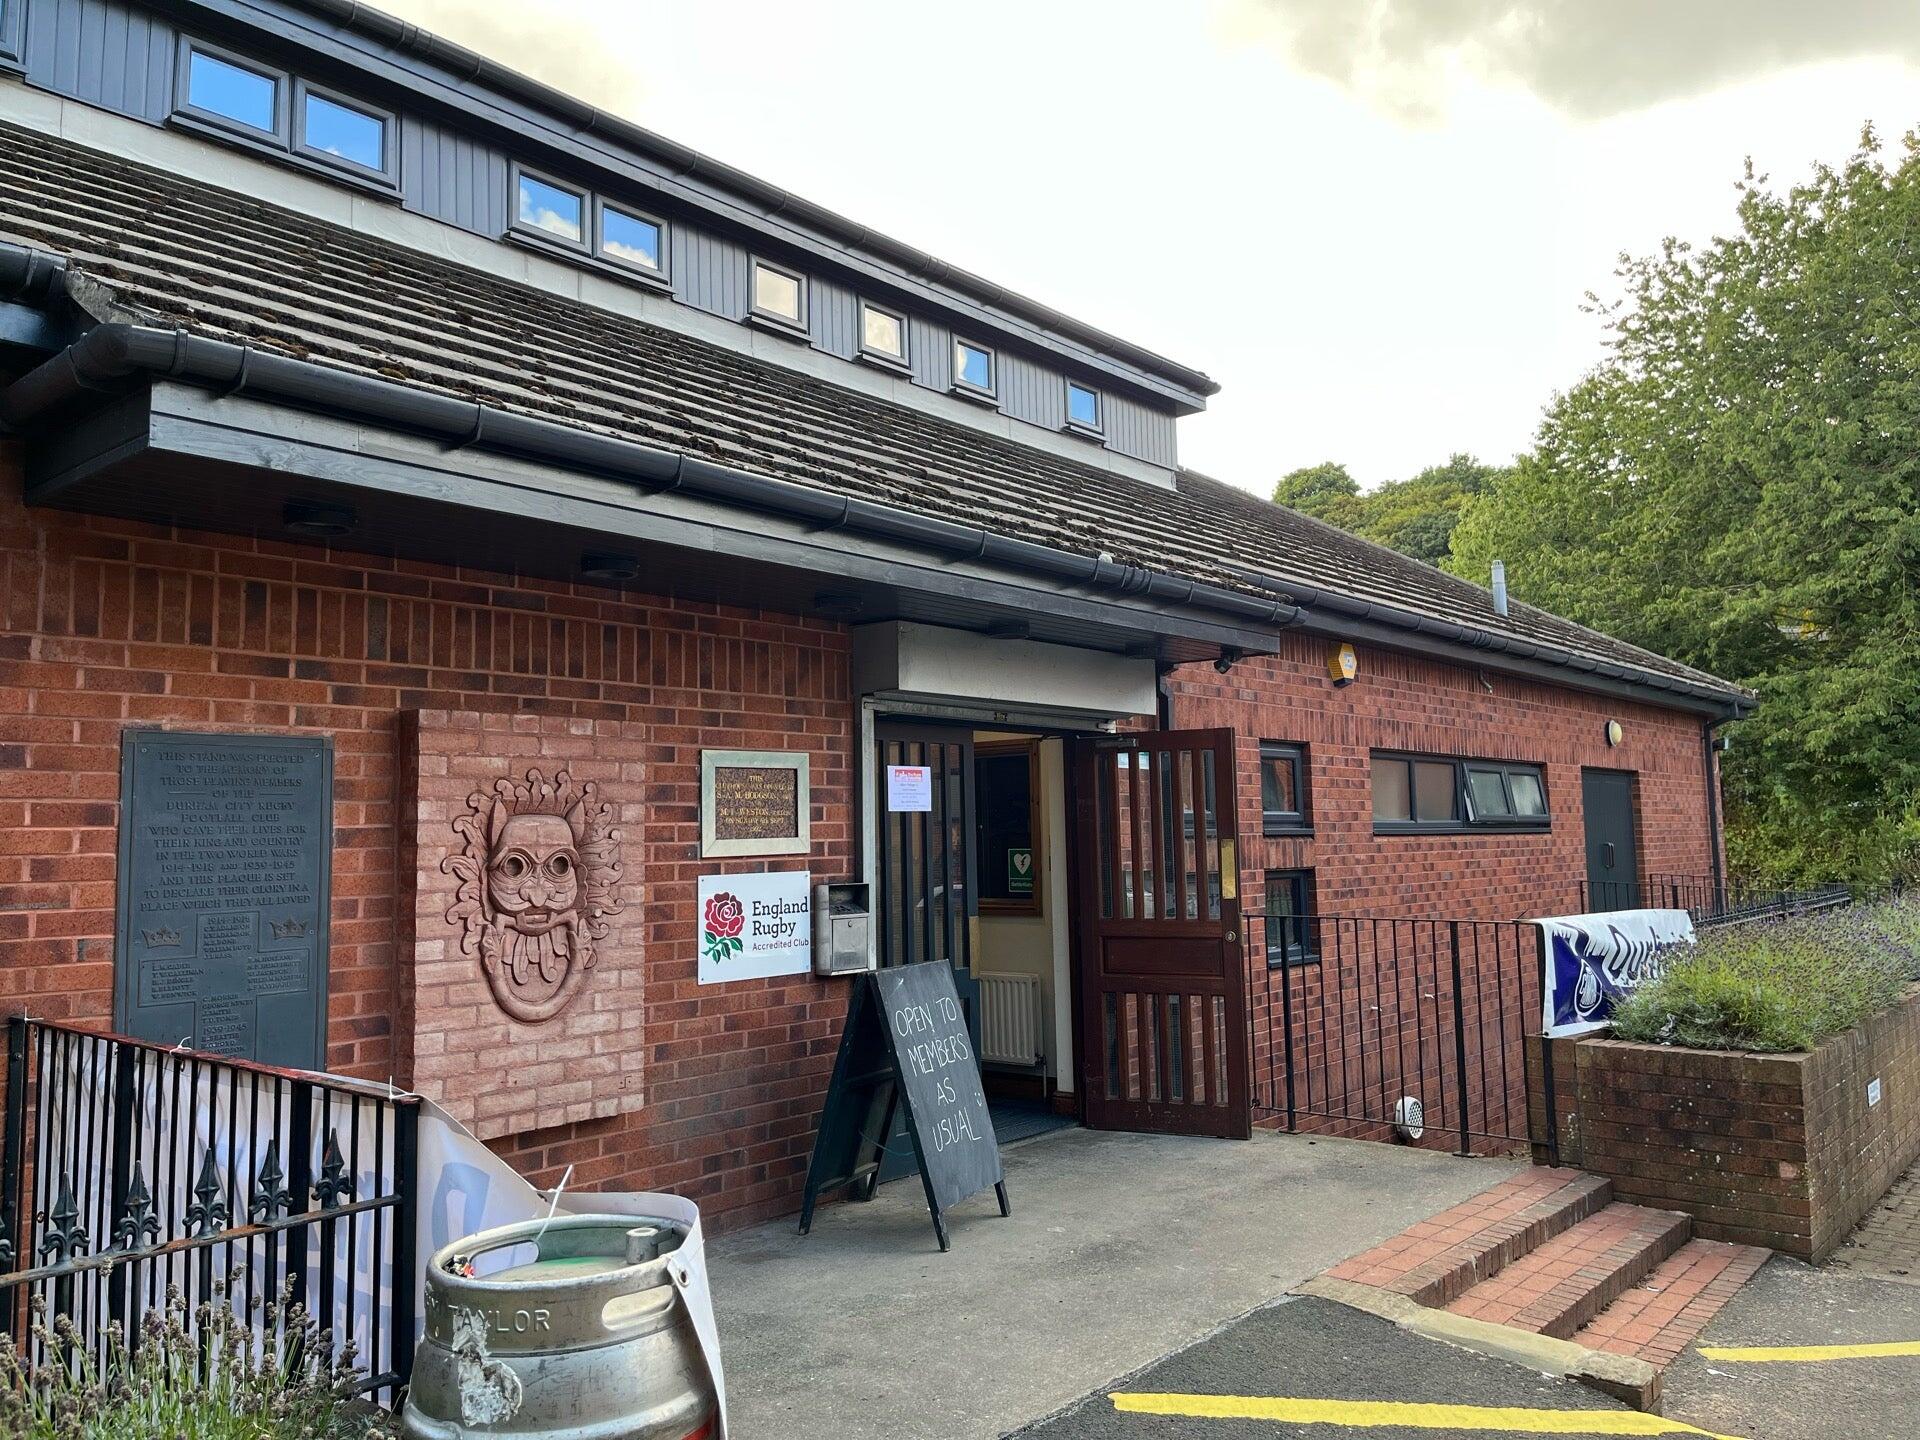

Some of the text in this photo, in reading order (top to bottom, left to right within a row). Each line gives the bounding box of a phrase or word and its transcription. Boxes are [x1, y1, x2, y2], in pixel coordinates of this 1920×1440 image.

[190, 752, 226, 762] STAND
[225, 801, 250, 810] CITY
[251, 813, 280, 822] CLUB
[149, 826, 178, 835] WHO
[183, 826, 214, 835] GAVE
[252, 825, 282, 834] LIVES
[286, 825, 307, 834] FOR
[154, 837, 304, 848] THEIR KING AND COUNTRY
[200, 851, 224, 859] TWO
[158, 876, 184, 886] AND
[188, 875, 213, 885] THIS
[218, 874, 261, 884] PLAQUE
[276, 872, 296, 881] SET
[144, 890, 159, 899] TO
[163, 888, 215, 898] DECLARE
[218, 887, 249, 896] THEIR
[252, 885, 286, 894] GLORY
[288, 884, 300, 893] IN
[139, 895, 311, 912] PLACE WHICH THEY ALL LOVED
[752, 896, 809, 920] England
[752, 917, 796, 938] Rugby
[752, 938, 809, 951] Accredited Club
[895, 997, 957, 1037] OPEN TO
[907, 1033, 969, 1077] MEMBERS
[936, 1077, 956, 1106] AS
[932, 1107, 982, 1152] USUAL
